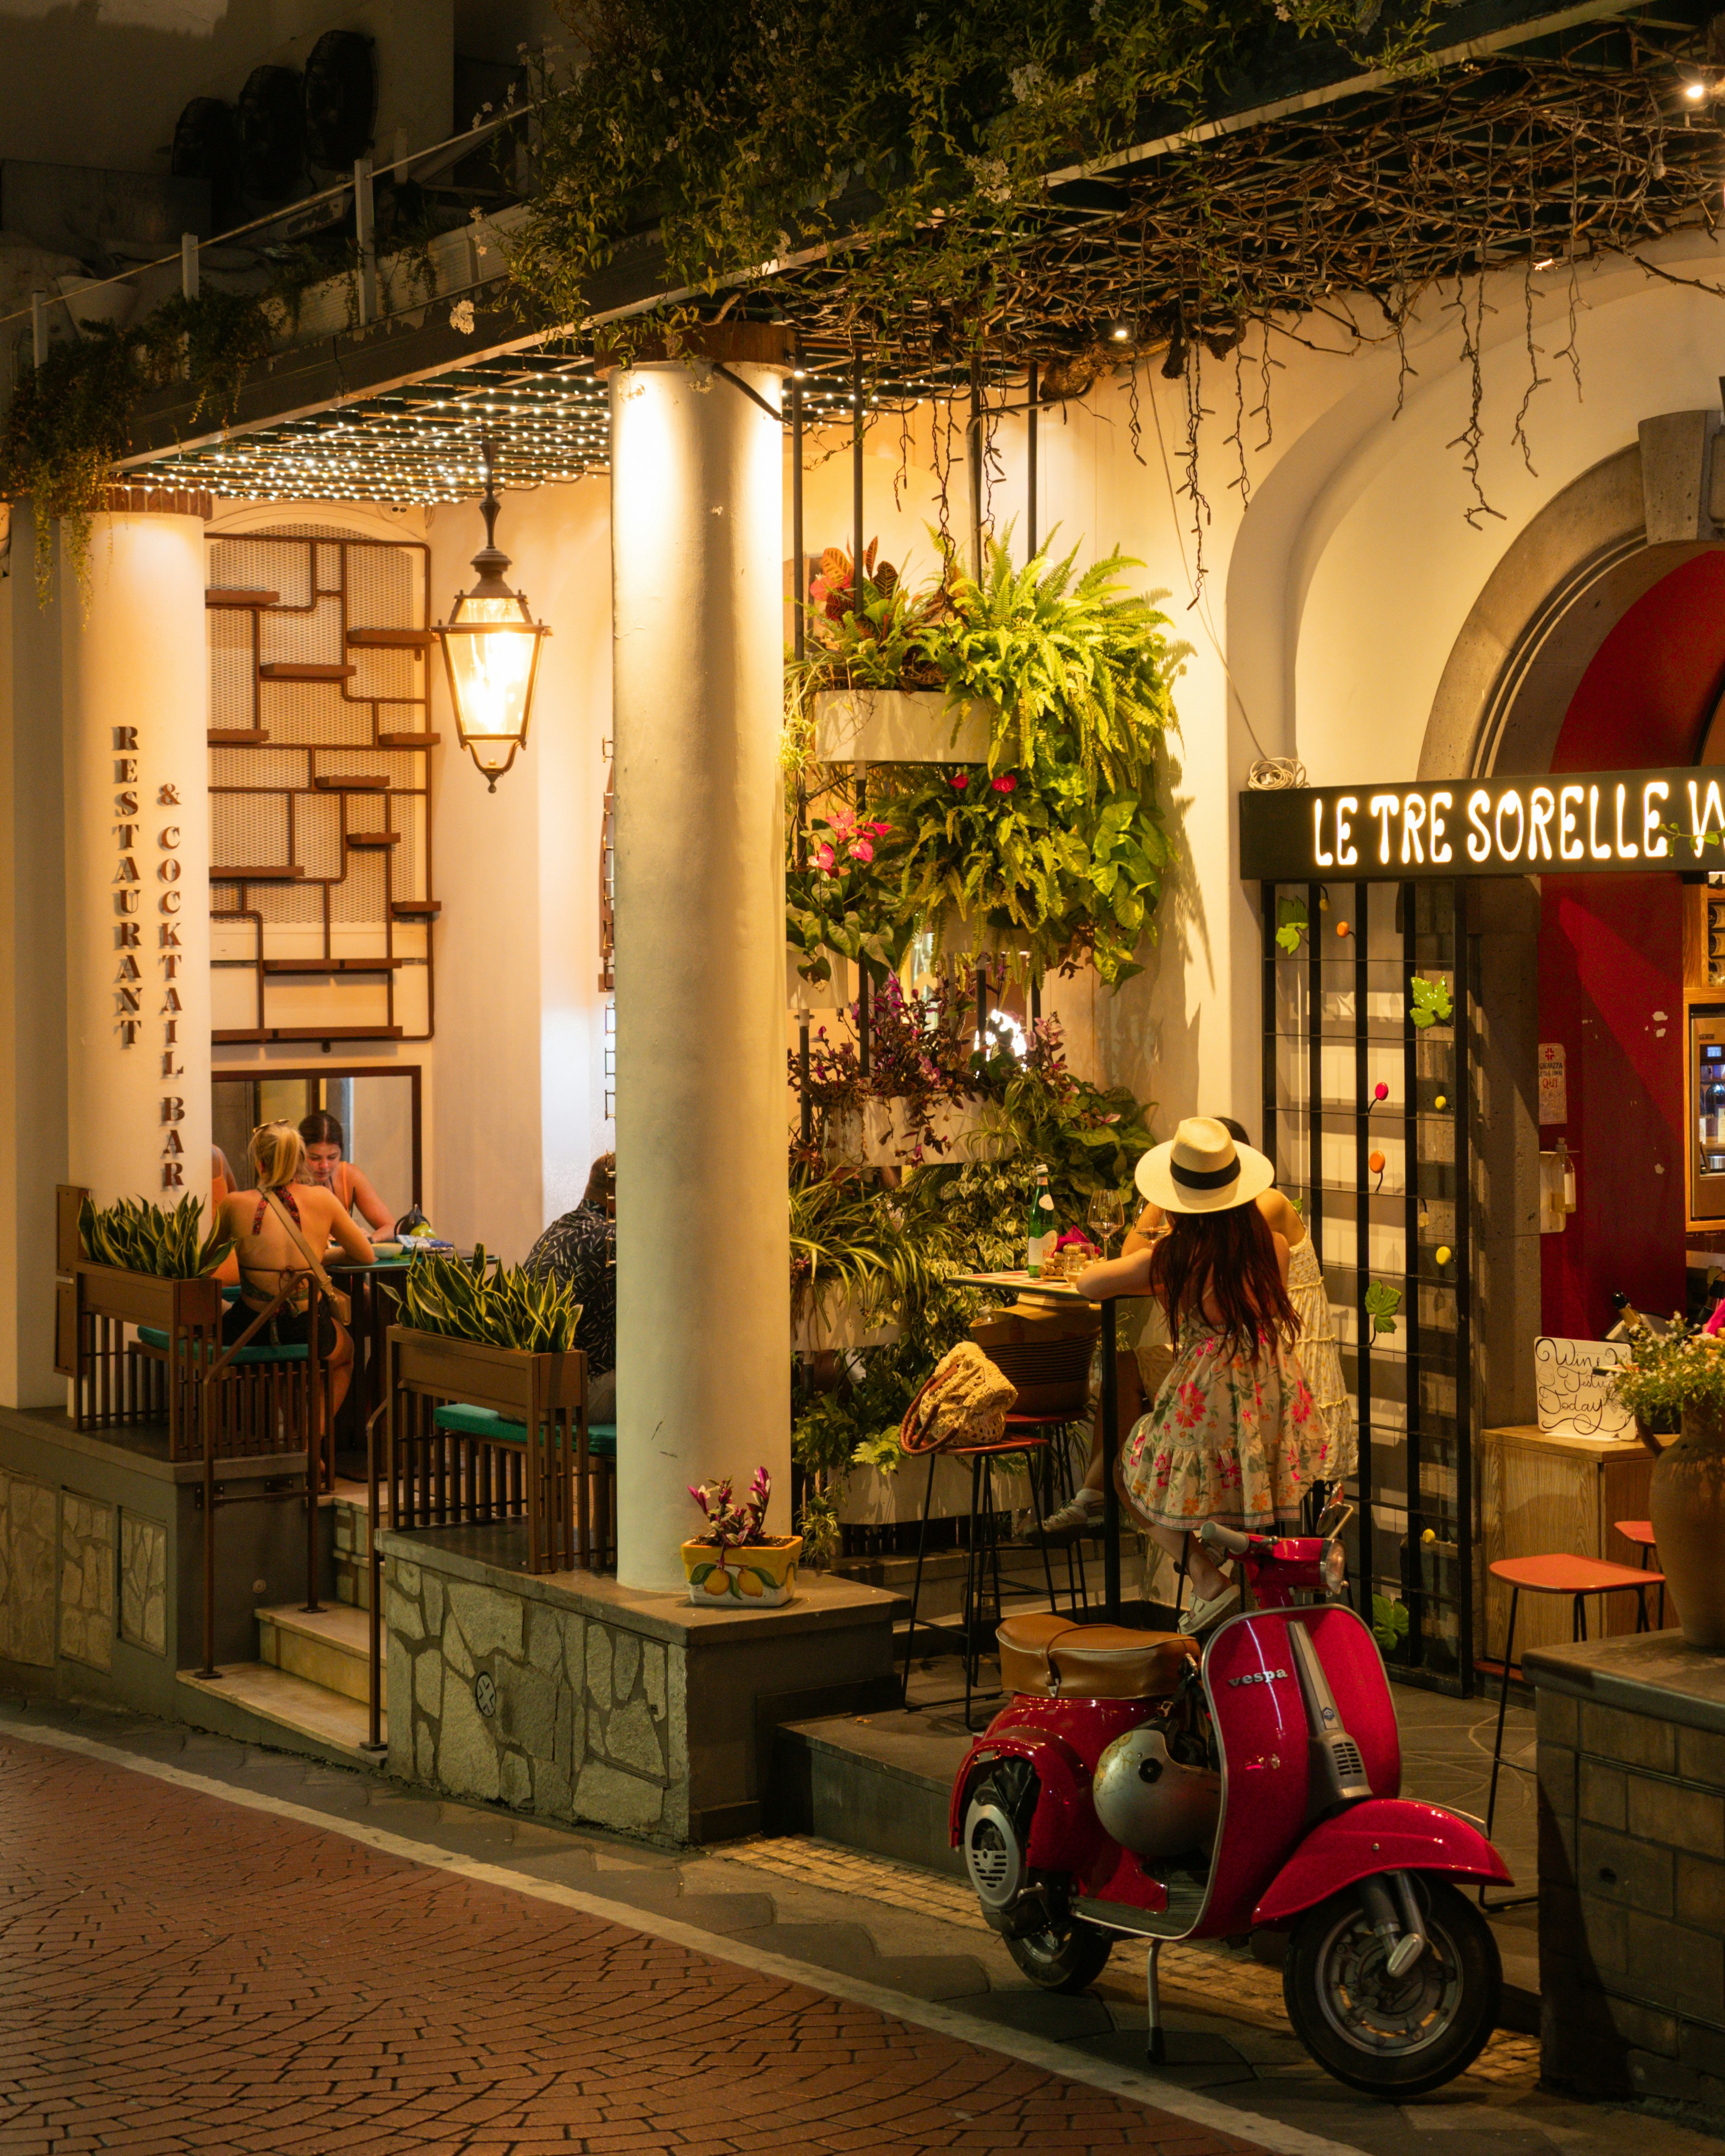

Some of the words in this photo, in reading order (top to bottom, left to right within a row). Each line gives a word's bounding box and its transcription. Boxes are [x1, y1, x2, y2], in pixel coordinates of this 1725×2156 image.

[160, 783, 182, 805] &
[1313, 797, 1359, 866] LE
[1370, 792, 1453, 864] TRE
[1467, 781, 1670, 862] SORELLE
[117, 725, 143, 1044] RESTAURANT
[161, 825, 185, 1075] COCKTAIL
[1543, 1077, 1558, 1089] QUI
[163, 1096, 185, 1187] BAR
[1535, 1337, 1600, 1367] Wine
[1538, 1386, 1603, 1435] Today
[1227, 1669, 1288, 1687] vespa
